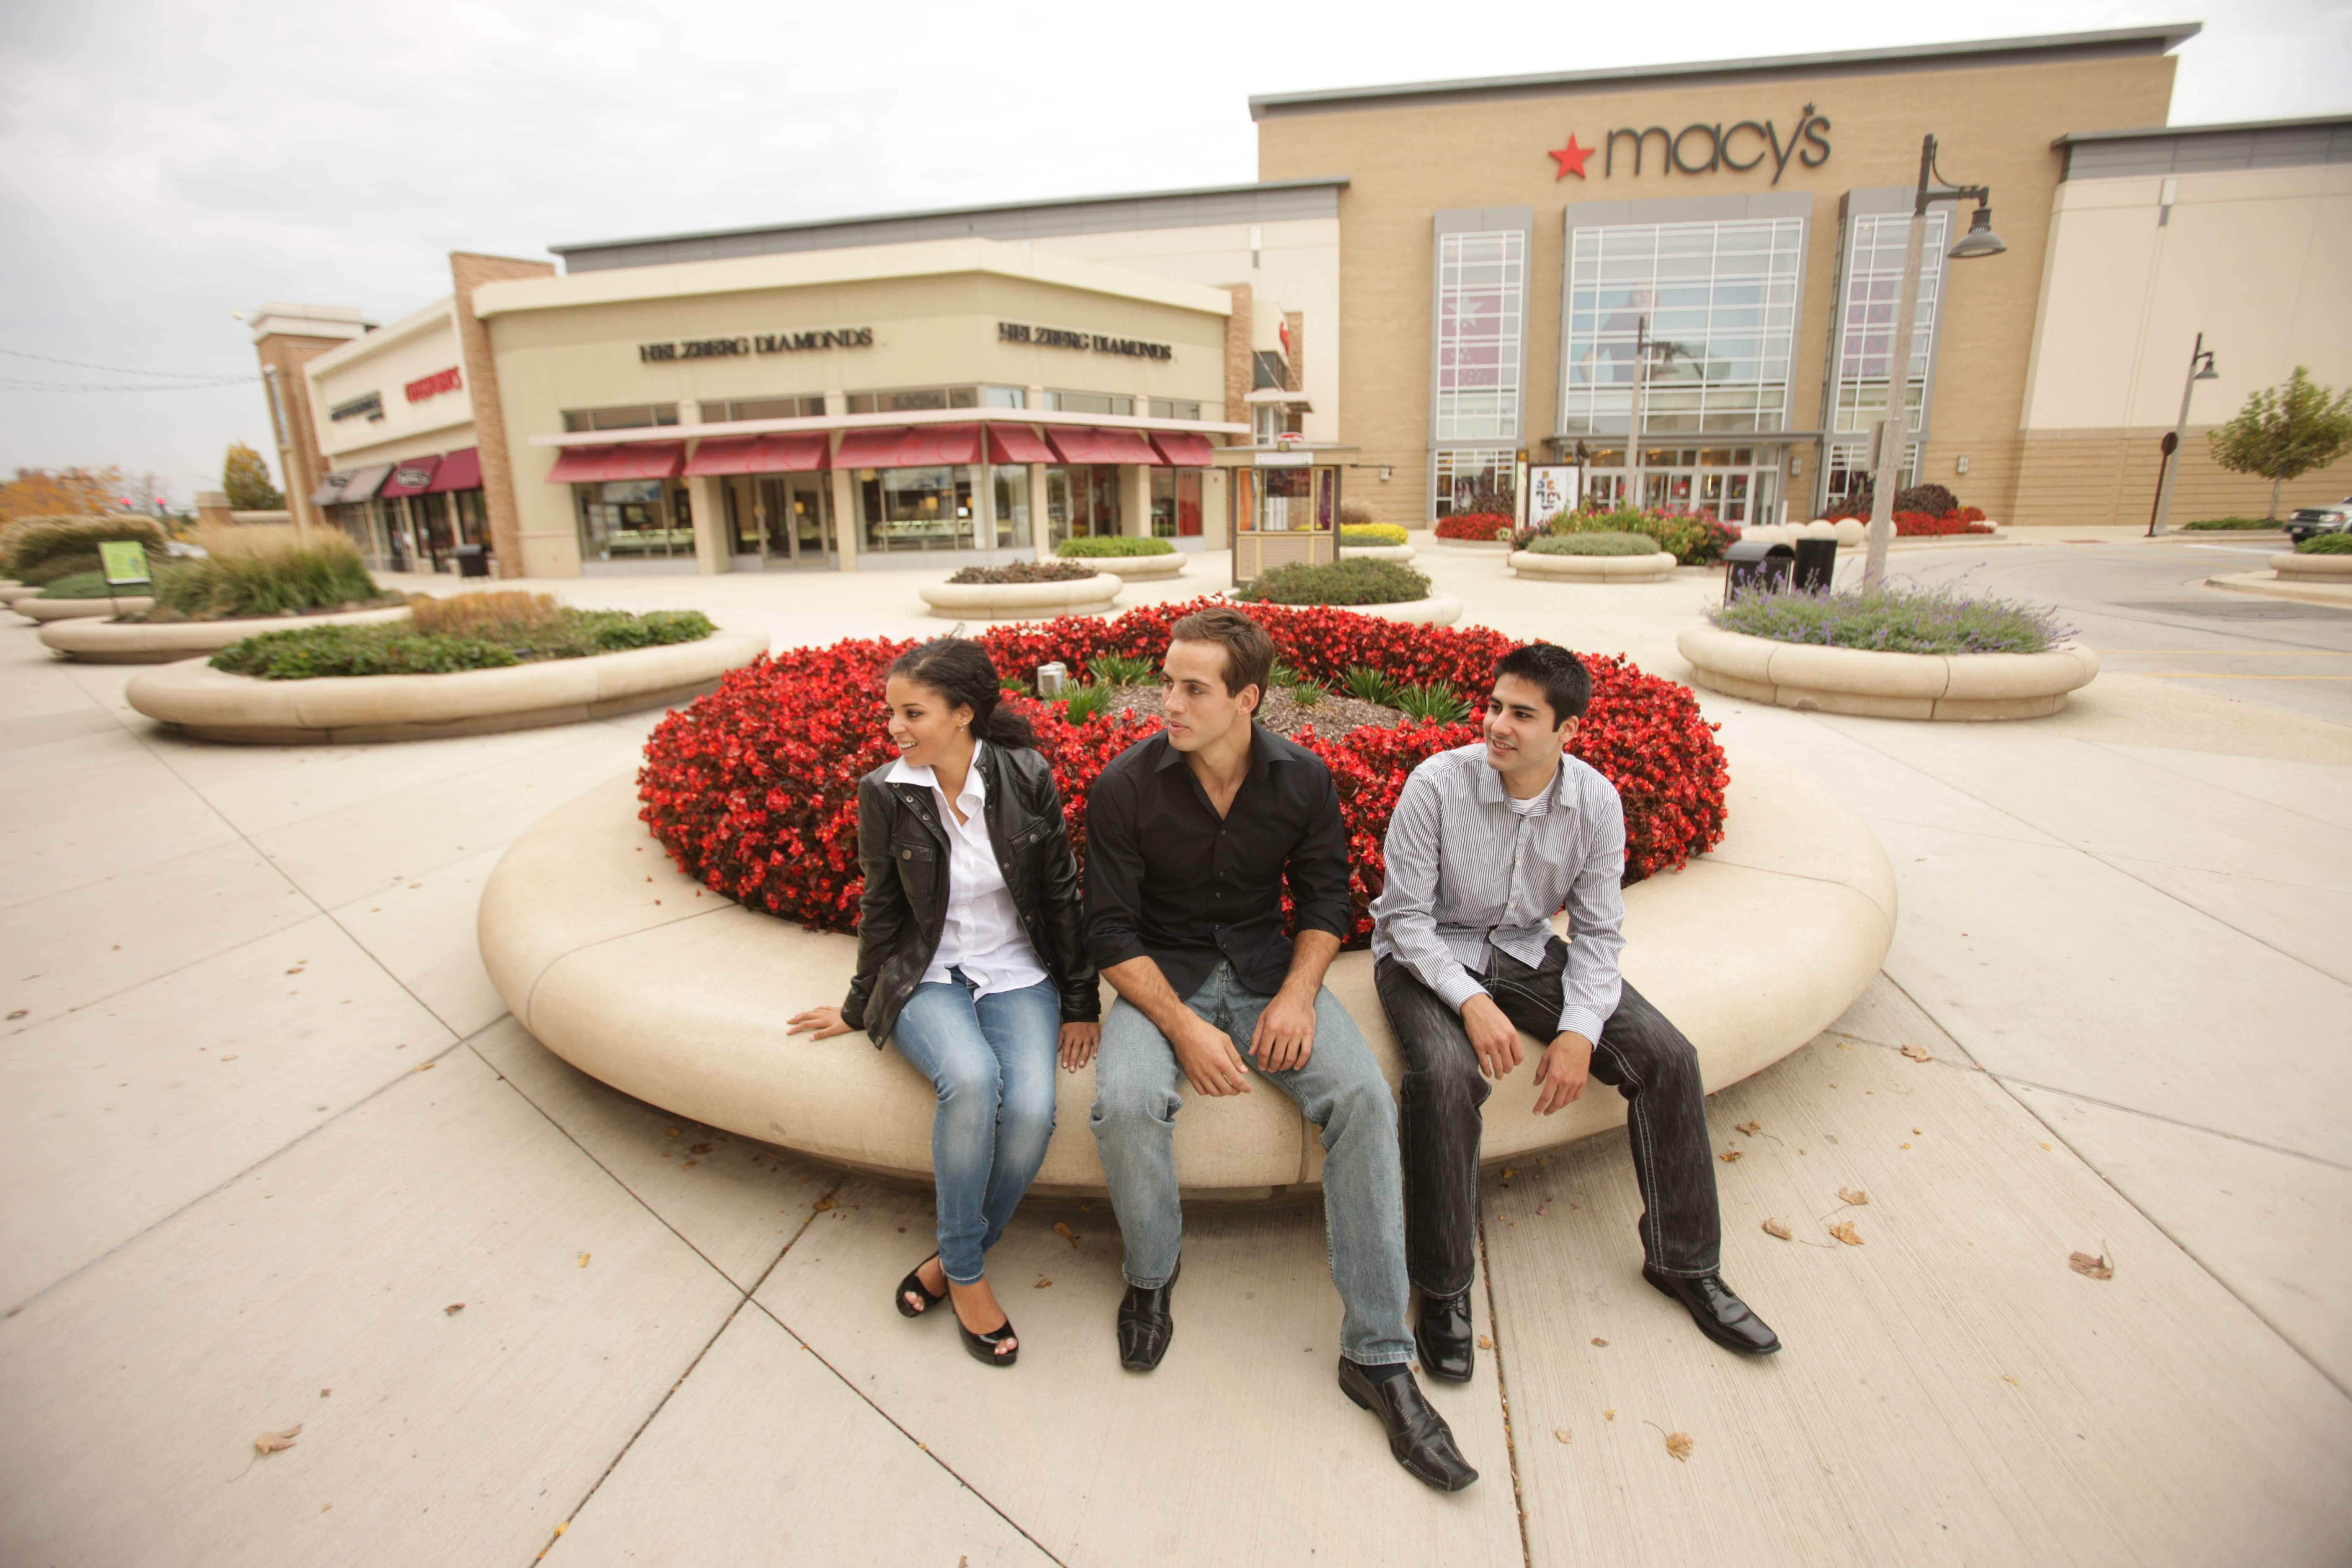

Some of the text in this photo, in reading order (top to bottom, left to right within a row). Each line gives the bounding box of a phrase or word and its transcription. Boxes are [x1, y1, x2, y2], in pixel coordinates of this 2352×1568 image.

[639, 327, 873, 362] HELZBERG DIAMONDS
[998, 322, 1172, 361] HELZBERG DIAMONDS
